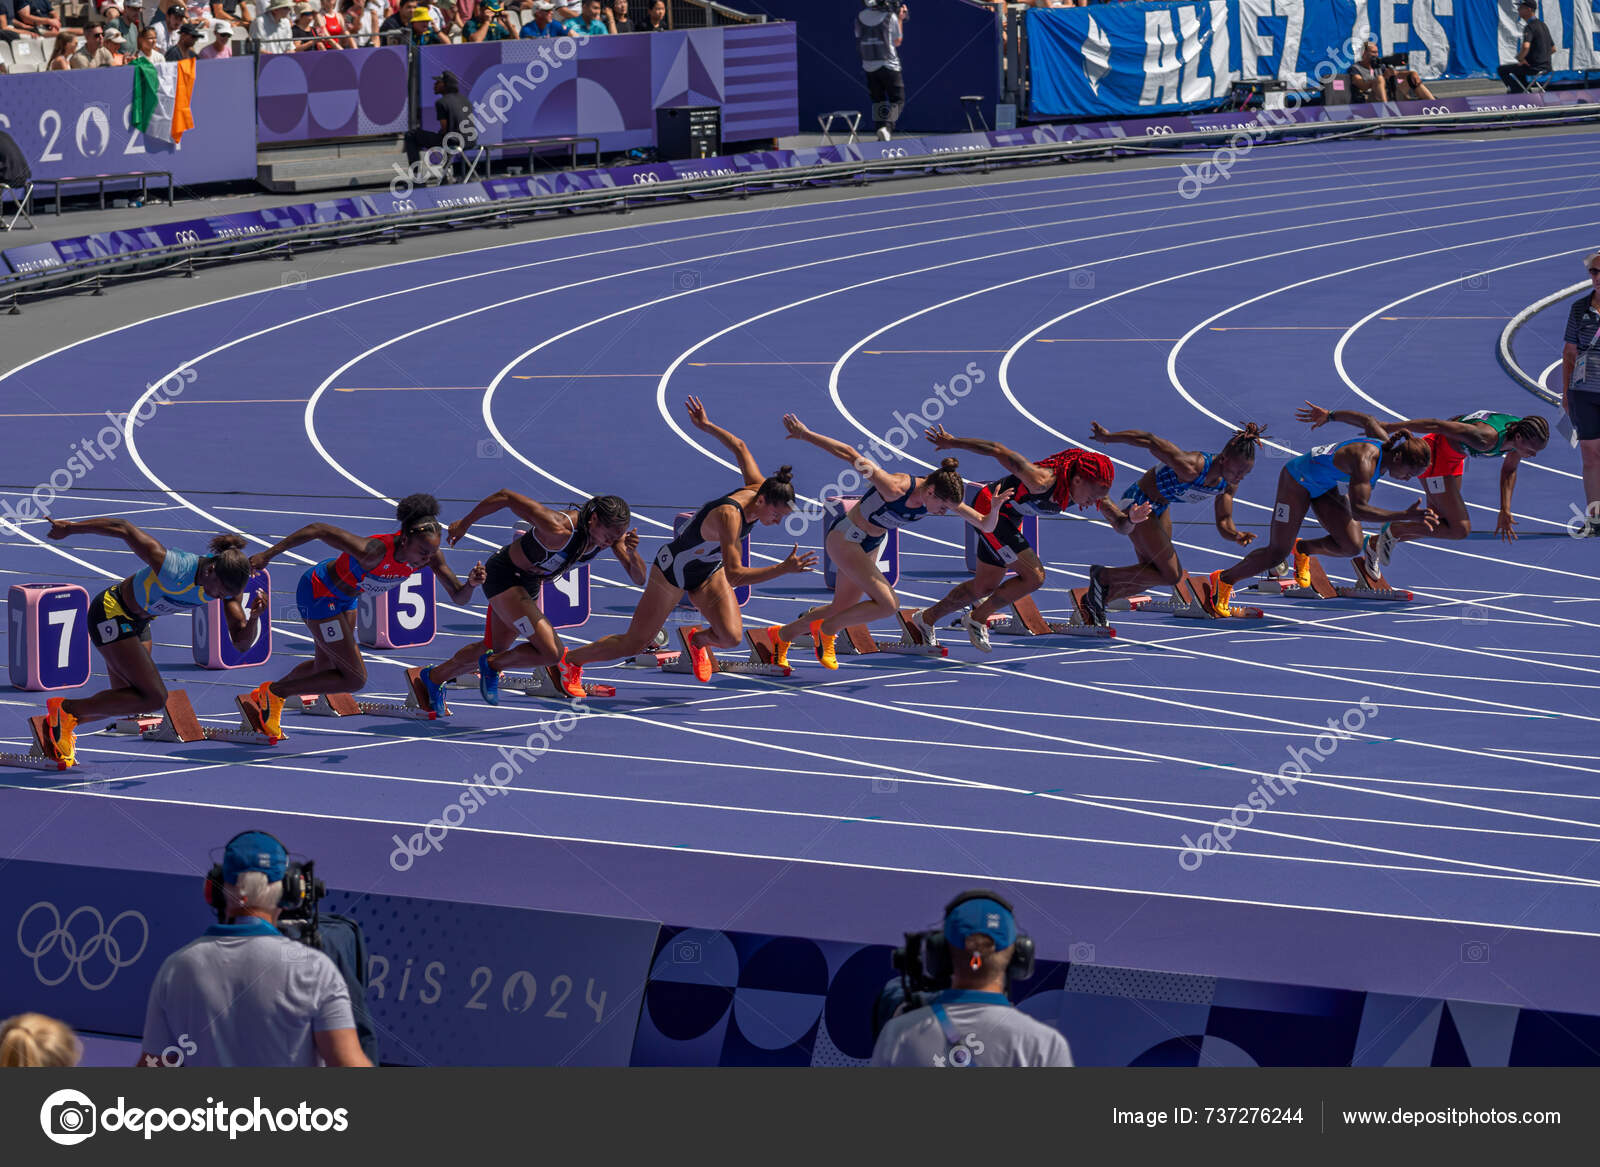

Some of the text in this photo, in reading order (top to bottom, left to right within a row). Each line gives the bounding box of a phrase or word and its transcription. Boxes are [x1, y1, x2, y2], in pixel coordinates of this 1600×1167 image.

[1138, 0, 1307, 105] ALLEZ
[397, 572, 426, 630] 5
[48, 608, 78, 668] 7
[105, 625, 113, 637] 9
[327, 626, 336, 637] 8
[464, 966, 608, 1023] 2024
